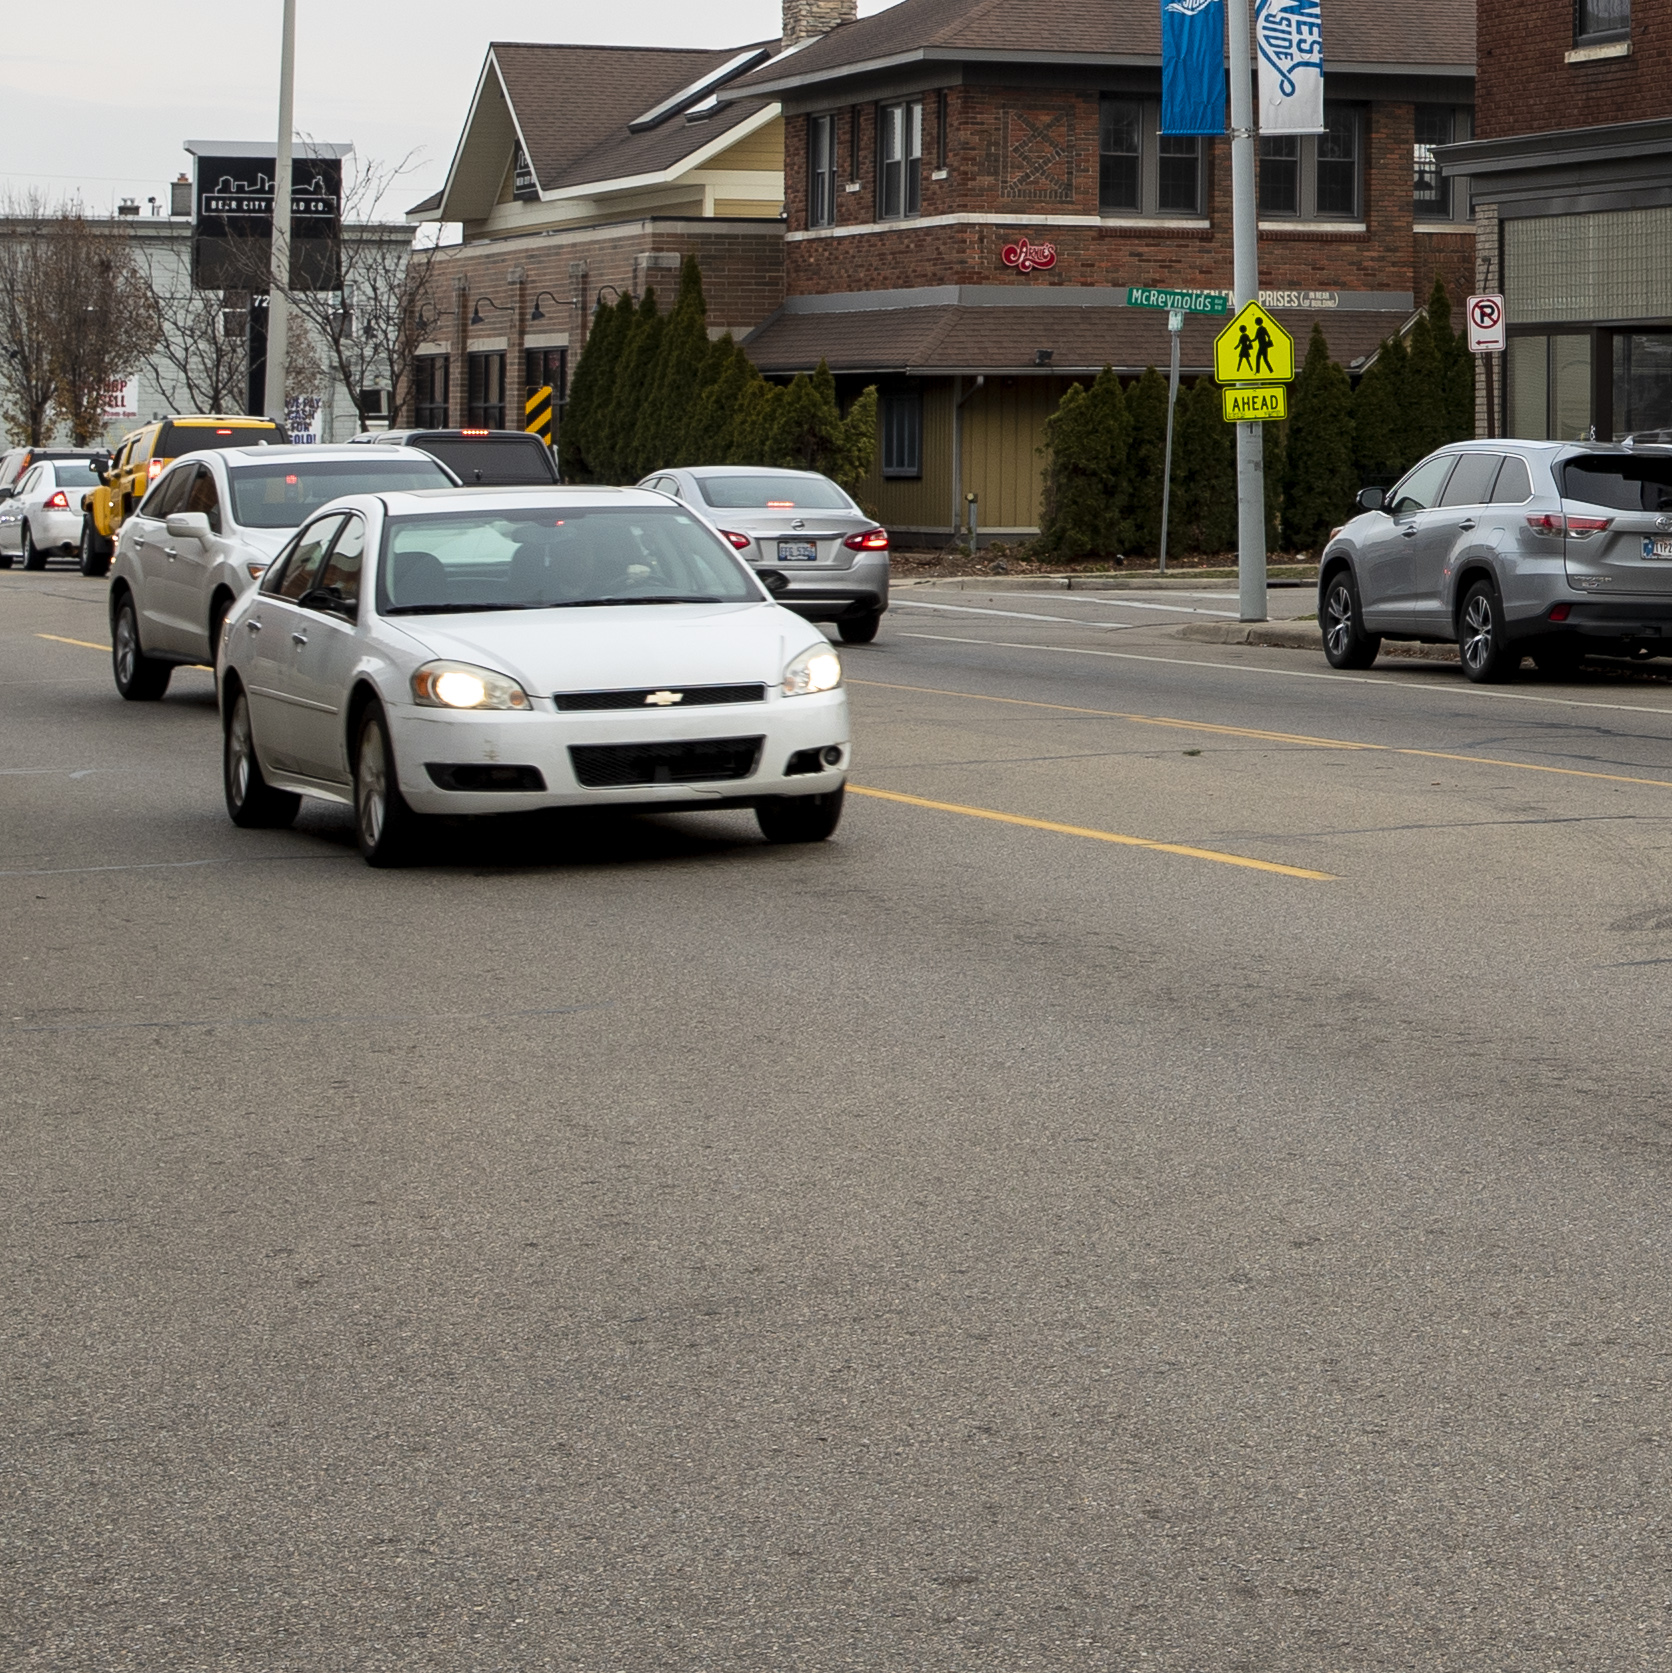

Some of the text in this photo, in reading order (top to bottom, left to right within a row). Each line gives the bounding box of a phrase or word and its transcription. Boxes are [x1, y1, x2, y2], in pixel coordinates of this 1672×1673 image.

[1262, 13, 1293, 62] SIDE
[242, 200, 267, 210] CITY
[1131, 289, 1212, 311] McReynolds
[1232, 394, 1278, 412] AHEAD
